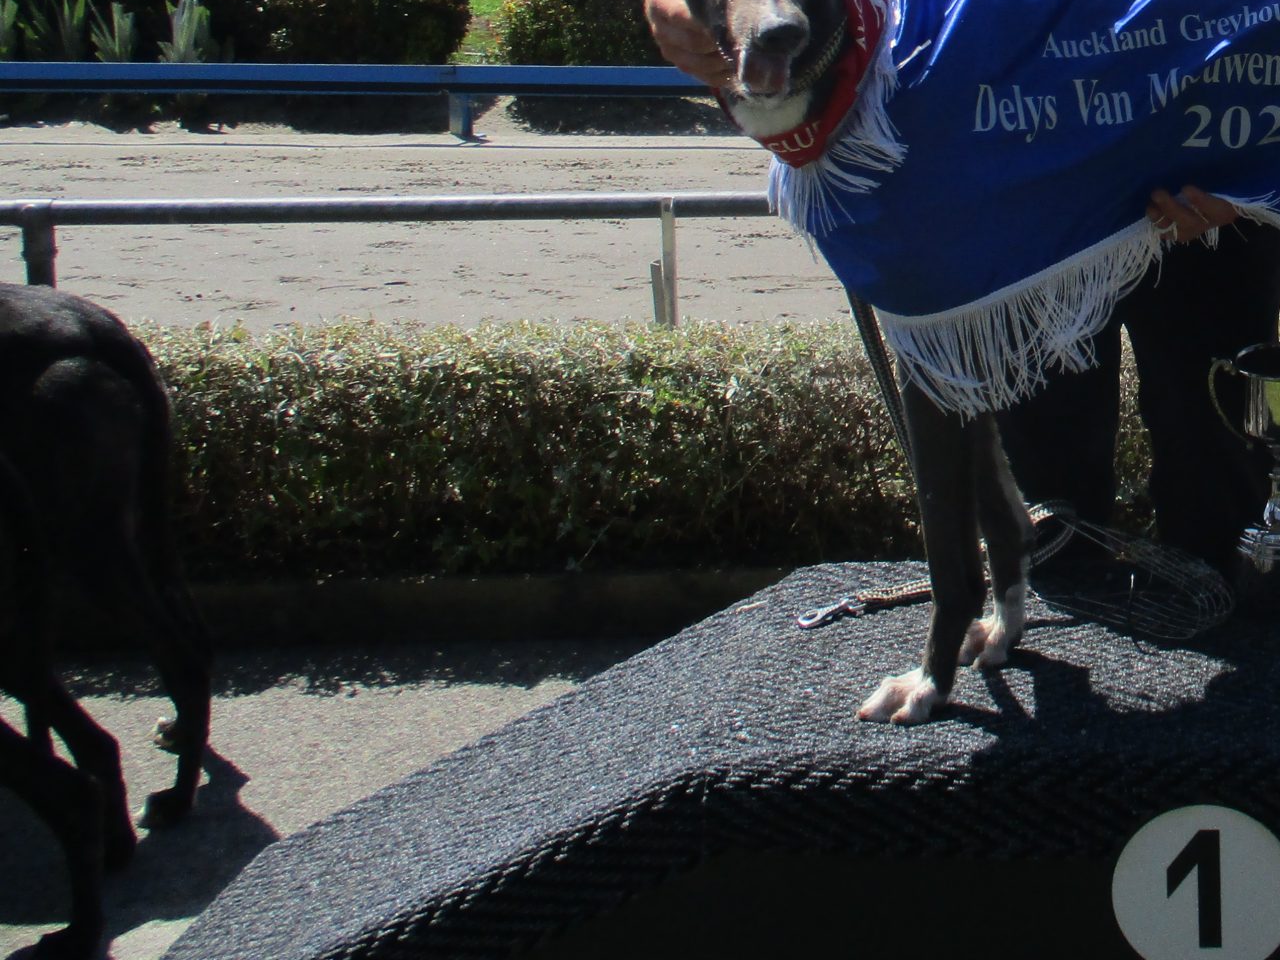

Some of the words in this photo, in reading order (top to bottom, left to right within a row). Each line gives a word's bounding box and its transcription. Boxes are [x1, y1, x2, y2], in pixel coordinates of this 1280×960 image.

[1041, 18, 1168, 59] Auckland
[767, 120, 821, 154] CLU
[972, 83, 1058, 144] Delys
[1073, 78, 1135, 127] Van
[1166, 828, 1223, 949] 1
